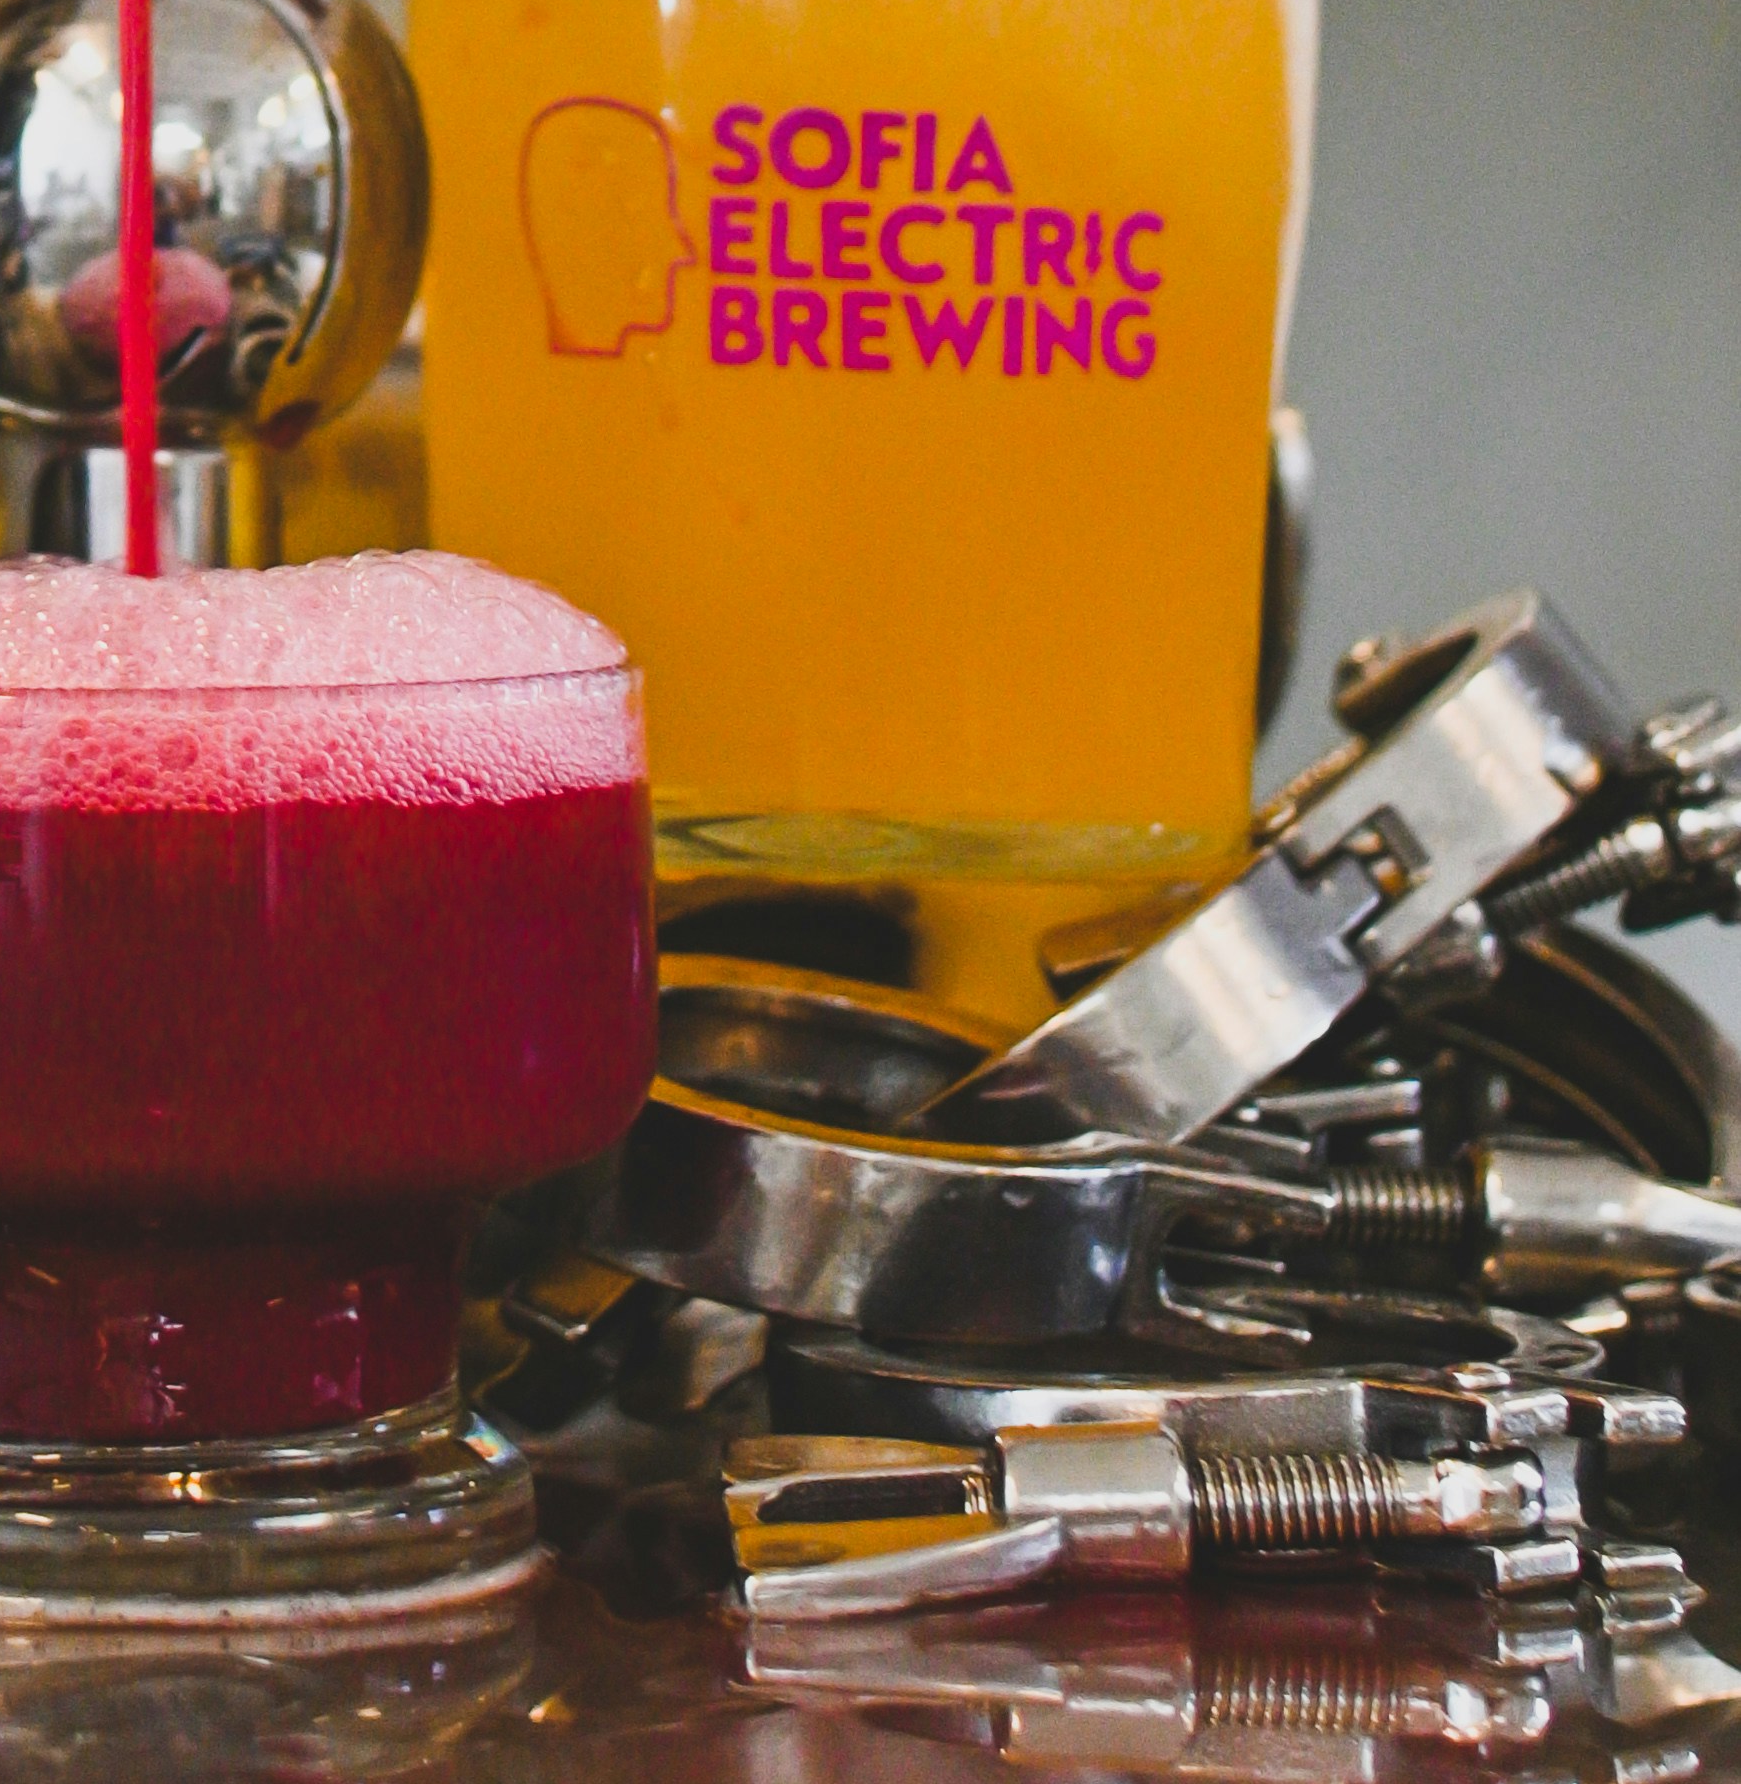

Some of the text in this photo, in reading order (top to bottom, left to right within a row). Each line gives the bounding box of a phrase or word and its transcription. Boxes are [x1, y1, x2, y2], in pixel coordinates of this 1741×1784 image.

[710, 104, 1014, 194] SOFIA
[708, 196, 1165, 292] ELECTRIC
[708, 285, 1158, 379] BREWING
